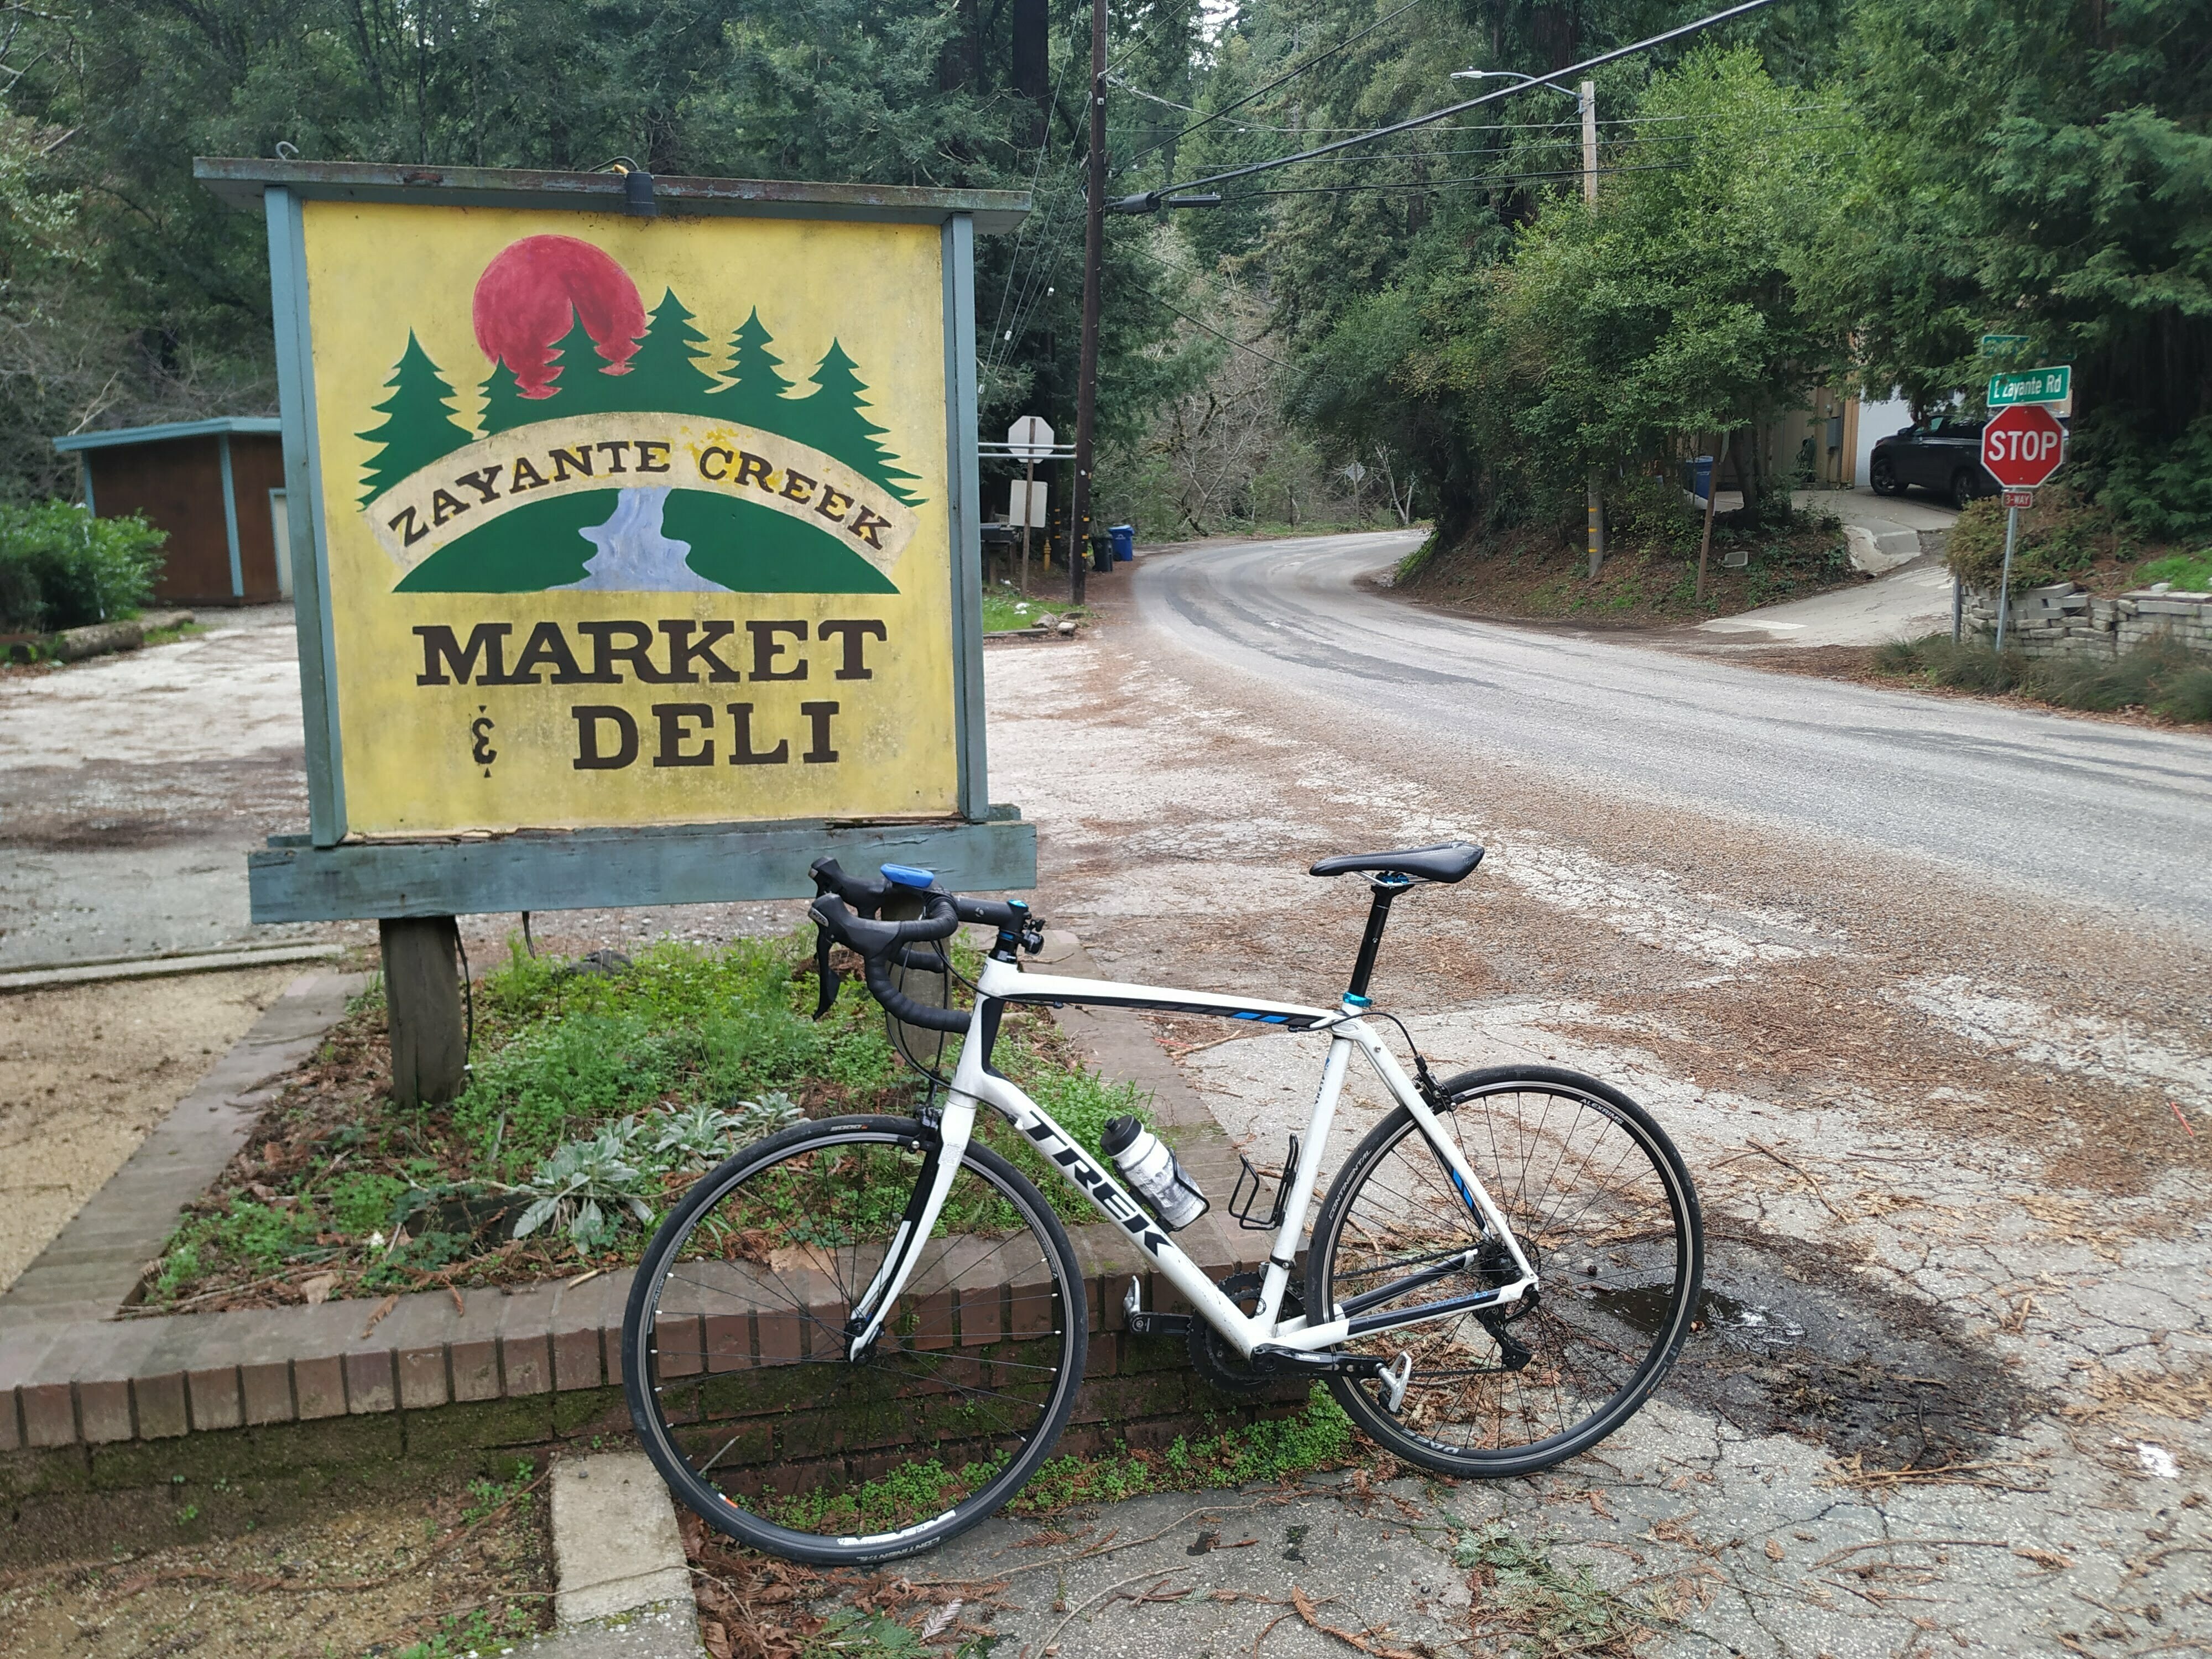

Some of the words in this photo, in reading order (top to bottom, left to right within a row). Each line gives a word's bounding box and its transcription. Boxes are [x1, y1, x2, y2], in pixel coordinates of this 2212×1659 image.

[2002, 377, 2042, 401] Zayante
[2046, 374, 2062, 393] Rd
[1988, 430, 2058, 461] STOP
[389, 441, 670, 547] ZAYANTE
[700, 445, 894, 550] CREEK
[2005, 494, 2030, 505] 3-WAY
[412, 619, 888, 686] MARKET
[571, 701, 839, 770] DELI
[1579, 1098, 1624, 1125] ALEXRIMS
[1024, 1110, 1175, 1258] TREK
[1328, 1149, 1372, 1221] CONTINENTAL
[1400, 1428, 1460, 1456] DA22
[855, 1536, 941, 1562] CONTINENTAL
